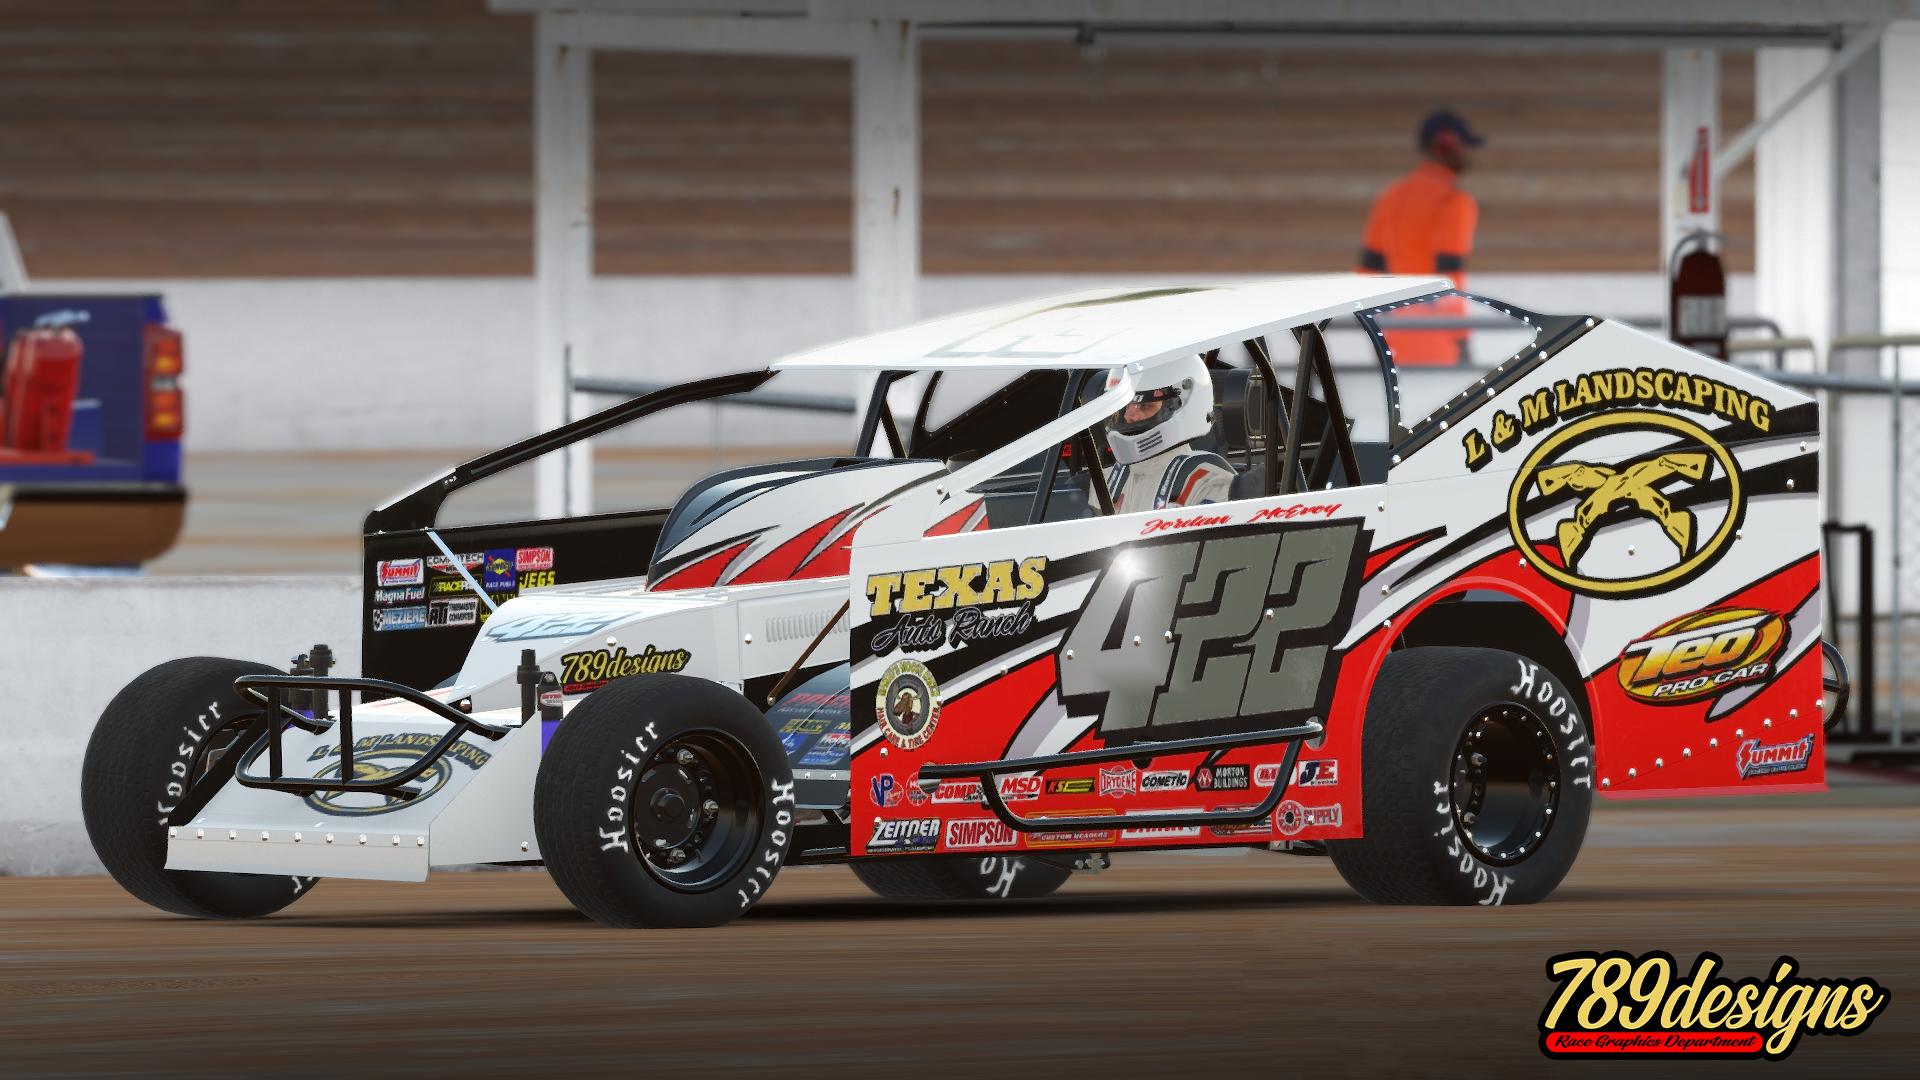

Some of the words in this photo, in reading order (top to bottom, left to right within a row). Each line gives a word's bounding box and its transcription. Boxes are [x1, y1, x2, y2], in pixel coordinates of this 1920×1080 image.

[1463, 429, 1490, 469] L
[1492, 411, 1519, 450] &
[1520, 389, 1555, 429] M
[1557, 368, 1773, 432] LANDSCAPING
[1140, 513, 1235, 535] Jordan
[1247, 503, 1343, 524] McEvoy
[518, 550, 552, 564] SIMPSON
[866, 556, 1050, 617] TEXAS
[871, 613, 943, 653] Auto
[948, 601, 1033, 643] Ranch
[1057, 519, 1362, 736] 422
[562, 646, 690, 684] 789designs
[1654, 676, 1709, 697] PRO
[1713, 662, 1770, 684] CAR
[1001, 777, 1042, 793] MSD
[1214, 777, 1248, 789] BUILDINGS
[1216, 767, 1245, 778] MORTON
[1300, 761, 1336, 785] JE
[871, 774, 895, 807] VP
[935, 784, 977, 800] COMP
[949, 821, 1014, 845] SIMPSON
